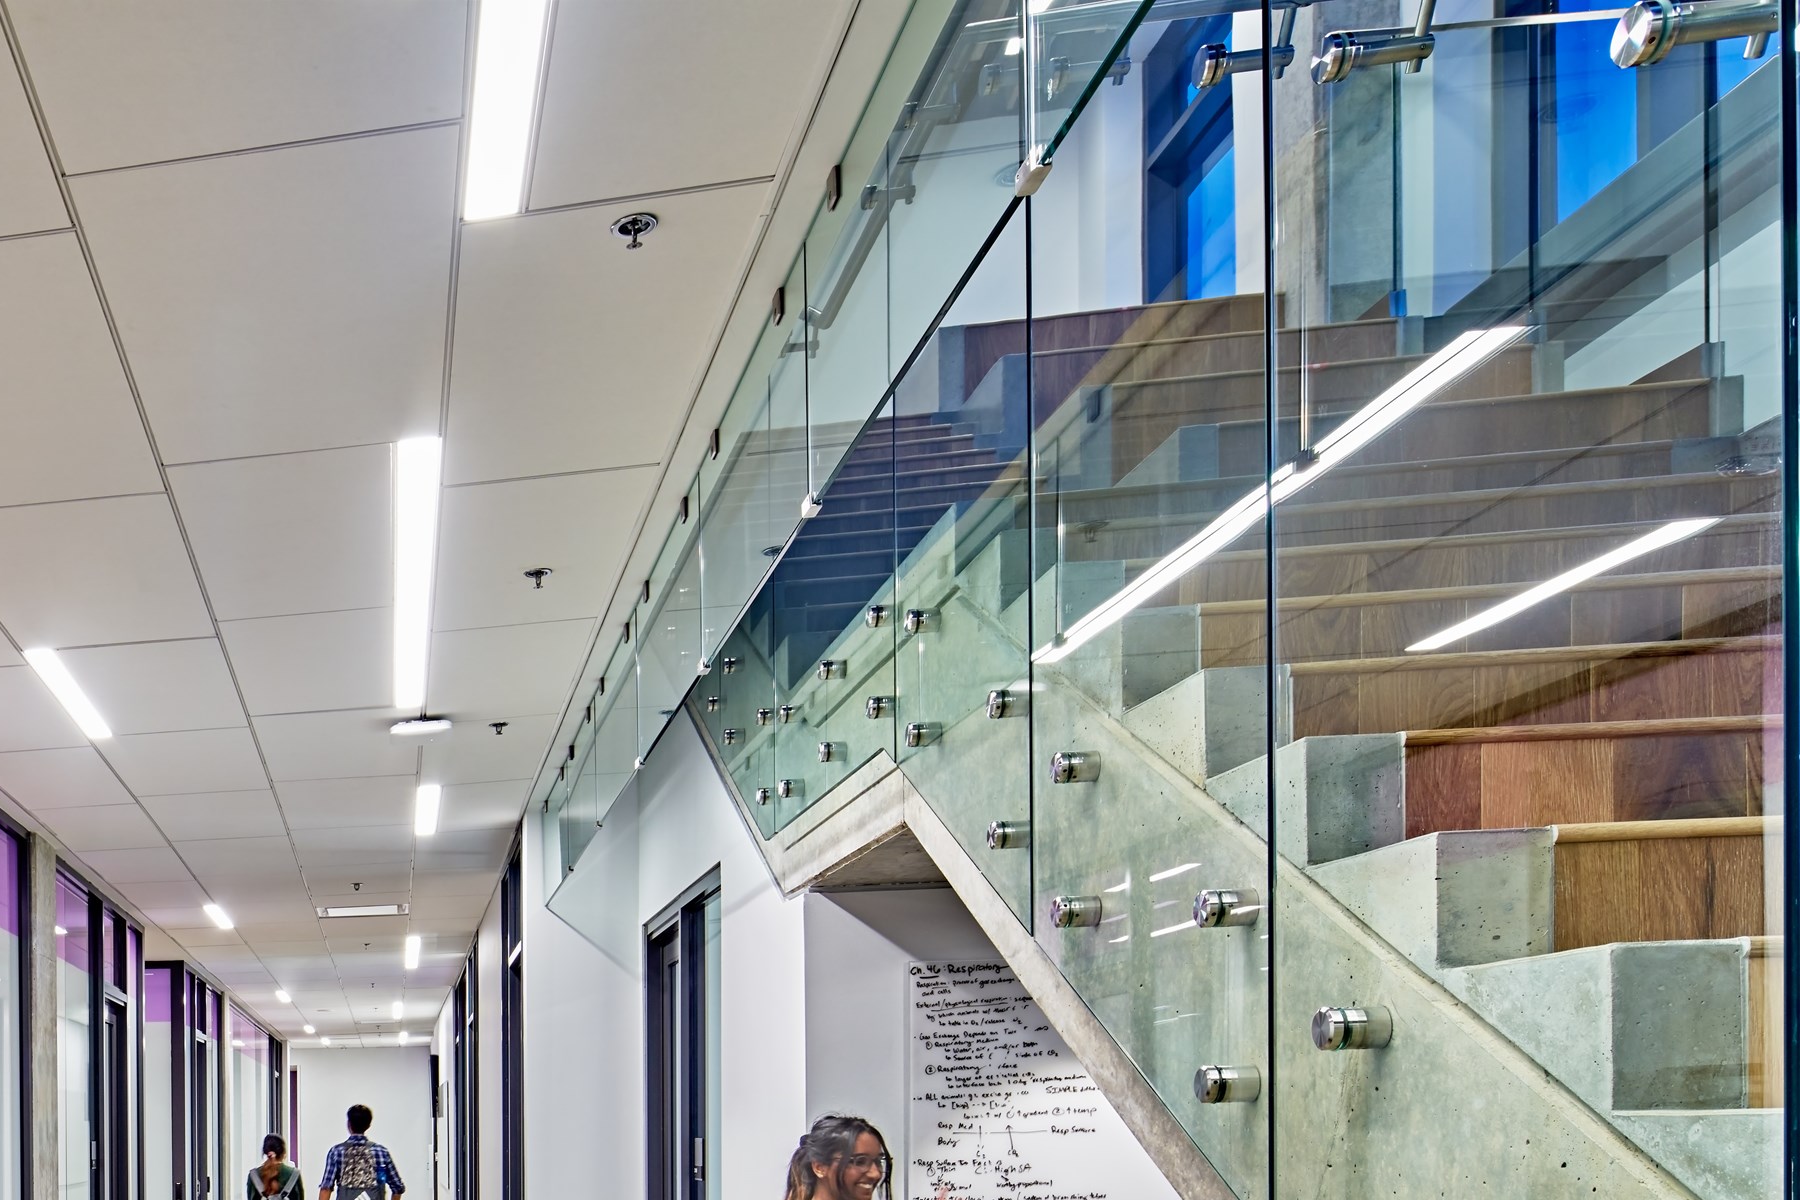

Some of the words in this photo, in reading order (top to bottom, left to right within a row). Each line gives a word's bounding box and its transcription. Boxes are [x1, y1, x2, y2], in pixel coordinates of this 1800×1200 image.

[947, 963, 1010, 976] Respiratory
[934, 1040, 974, 1048] Respiratory
[937, 1064, 983, 1075] Respiratory
[1045, 1086, 1078, 1094] SIMPLE
[925, 1093, 939, 1101] ALL
[1050, 1125, 1069, 1135] Resp
[937, 1136, 960, 1148] Body
[937, 1165, 956, 1173] Thin
[995, 1165, 1016, 1176] High
[1018, 1163, 1032, 1174] SA
